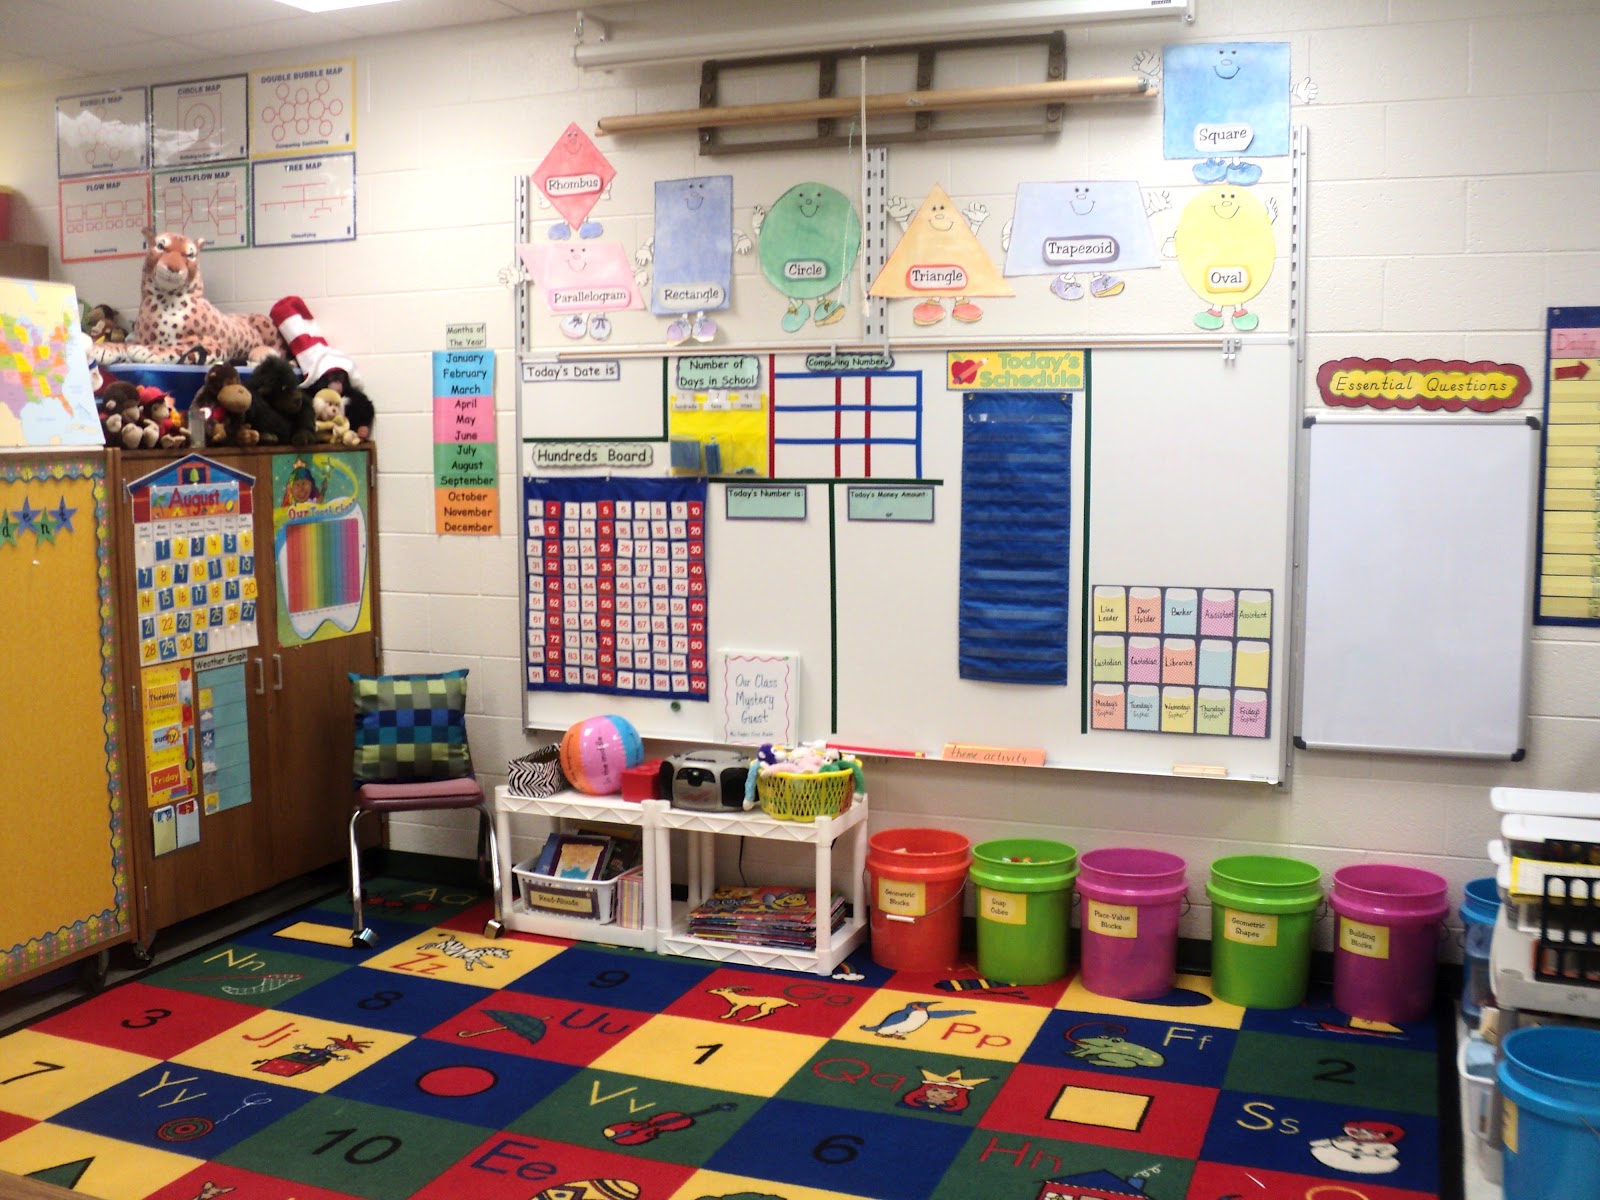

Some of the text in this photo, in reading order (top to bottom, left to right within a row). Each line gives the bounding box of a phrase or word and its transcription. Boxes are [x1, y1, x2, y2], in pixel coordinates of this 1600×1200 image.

[260, 67, 343, 84] DOUBLE BUBBLE MAP
[177, 84, 221, 95] CIRCLE MAP
[79, 95, 123, 107] BUBBLE MAP
[1199, 128, 1247, 144] Square
[284, 162, 322, 173] TREE MAP
[169, 171, 231, 184] MULTI-FLOW MAP
[86, 181, 121, 192] FLOW MAP
[548, 179, 599, 191] Rhombus
[1048, 242, 1113, 257] Trapezoid
[788, 263, 823, 276] Circle
[912, 269, 963, 285] Triangle
[1210, 271, 1242, 284] Oval
[553, 290, 626, 305] Parallelogram
[664, 287, 719, 303] Rectangle
[447, 324, 485, 335] Months of
[450, 339, 463, 347] The
[446, 353, 484, 364] January
[689, 359, 745, 370] Number of
[997, 352, 1080, 373] Today's
[443, 369, 487, 379] February
[526, 364, 616, 380] Today's Date is
[680, 374, 755, 388] Days in School
[980, 370, 1081, 388] Schedule
[1335, 374, 1508, 393] Essential Questions
[450, 384, 481, 395] March
[454, 399, 477, 411] April
[456, 415, 476, 426] May
[454, 431, 478, 441] June
[456, 445, 477, 456] July
[537, 449, 647, 462] Hundreds Board
[451, 461, 484, 472] August
[440, 476, 494, 487] September
[448, 491, 488, 502] October
[729, 488, 759, 499] Today's
[760, 488, 791, 498] Number
[850, 491, 876, 500] Today's
[877, 491, 899, 500] Money
[168, 487, 220, 516] August
[288, 508, 309, 520] Our
[443, 506, 493, 517] November
[550, 505, 700, 516] 2 10
[444, 522, 493, 532] December
[690, 526, 701, 536] 20
[178, 537, 233, 555] 2 3 4 5
[547, 544, 701, 555] 22 30
[194, 559, 251, 577] 10 13
[690, 565, 702, 575] 40
[195, 583, 256, 601] 17 20
[691, 603, 704, 612] 60
[1100, 605, 1114, 614] Line
[1137, 606, 1151, 615] Door
[161, 605, 254, 632] 22 27
[1134, 615, 1156, 624] Holder
[691, 622, 703, 632] 70
[144, 638, 192, 658] 28 29 30
[195, 652, 247, 669] Weather Graph
[1165, 656, 1193, 668] Librarian
[691, 680, 706, 690] 100
[735, 673, 778, 688] Our Class
[149, 692, 177, 702] Thursday
[735, 691, 775, 710] Mystery
[741, 709, 769, 724] Guest
[154, 732, 178, 744] sunny
[951, 745, 1028, 765] theme activity
[153, 773, 180, 787] Friday
[885, 888, 916, 898] Geometric
[889, 898, 910, 907] Blocks
[991, 898, 1007, 908] Snap
[990, 906, 1009, 916] Cubes
[1094, 909, 1131, 922] Place-Value
[1100, 920, 1122, 931] Blocks
[1231, 917, 1266, 929] Geometric
[1235, 927, 1260, 939] Shapes
[1348, 928, 1376, 943] Building
[1350, 939, 1373, 950] Blocks
[389, 953, 449, 975] Zz
[588, 970, 630, 989] 9
[357, 990, 404, 1010] 8
[121, 1008, 172, 1029] 3
[558, 1008, 632, 1036] Uu
[940, 1022, 1013, 1049] Pp
[1163, 1026, 1214, 1051] Ff
[693, 1043, 723, 1066] 1
[0, 1060, 66, 1086] 7
[1313, 1058, 1357, 1085] 2
[1236, 1101, 1300, 1135] Ss
[311, 1127, 402, 1165] 10
[812, 1133, 866, 1165] 6
[471, 1138, 558, 1181] Ee
